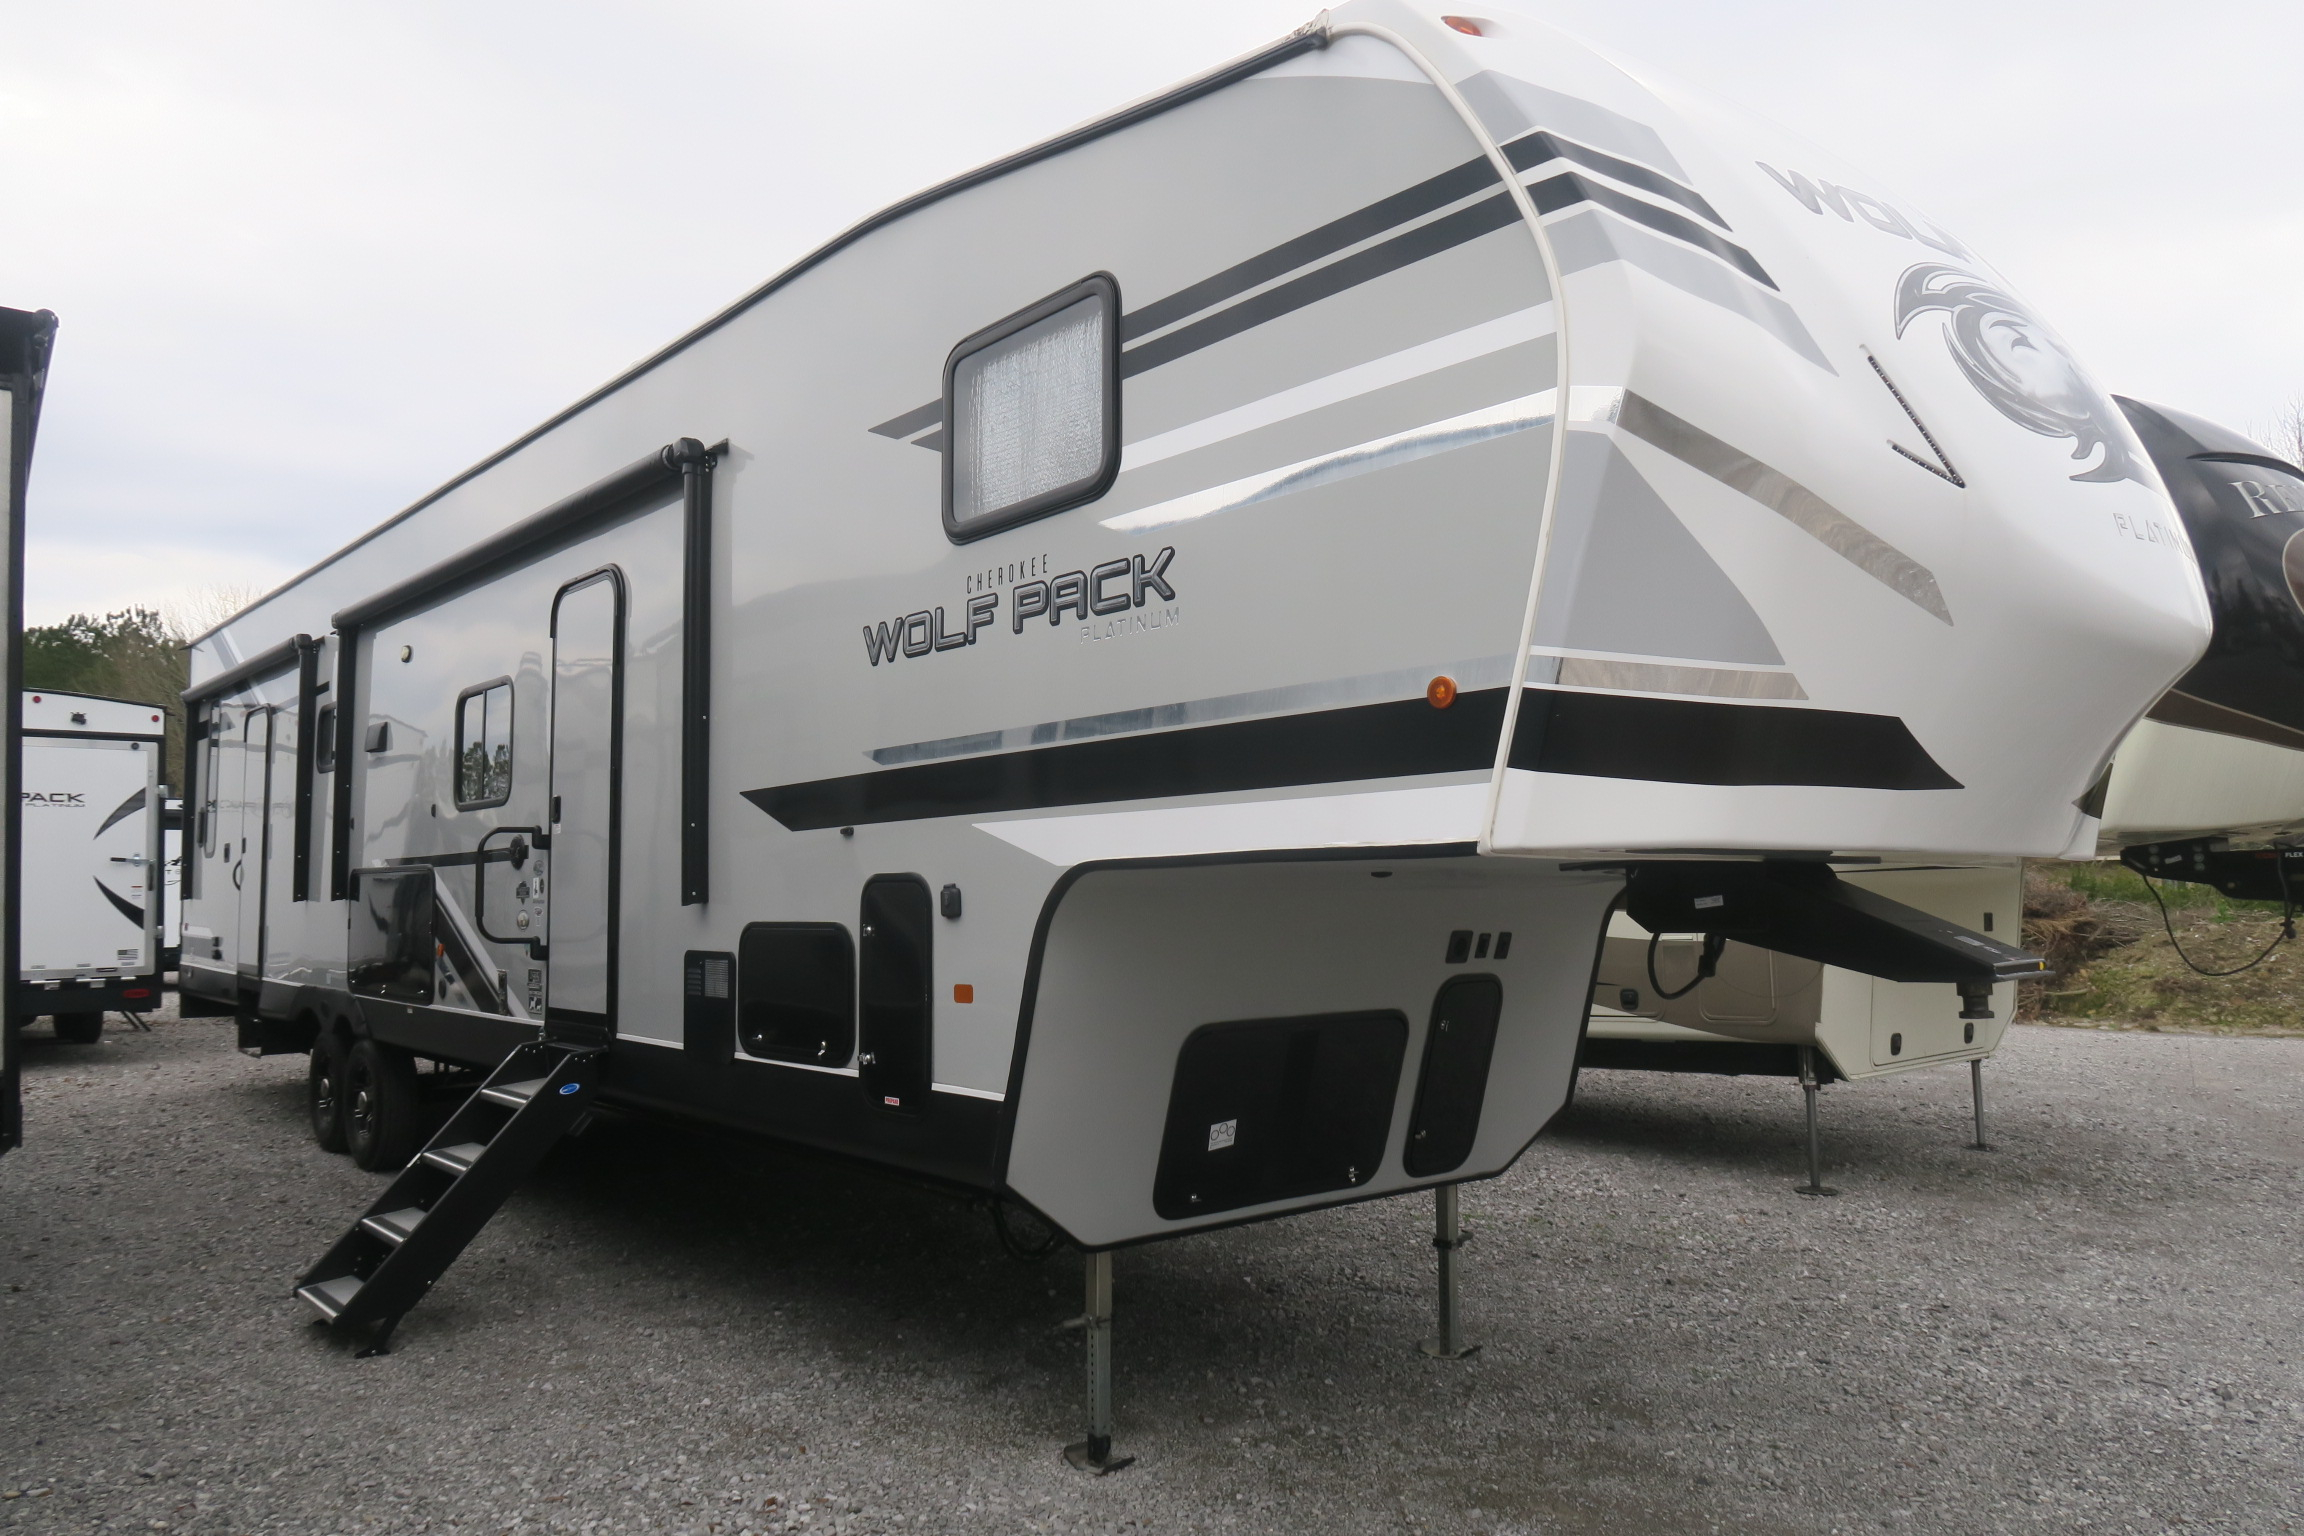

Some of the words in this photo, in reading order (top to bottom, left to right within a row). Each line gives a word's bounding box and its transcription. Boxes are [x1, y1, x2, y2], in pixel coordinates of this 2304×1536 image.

[2227, 480, 2304, 519] RE
[967, 554, 1048, 594] CHEROKEE
[863, 592, 998, 666] WOLF
[1012, 546, 1175, 634] PACK
[1080, 607, 1180, 645] PLATINUM
